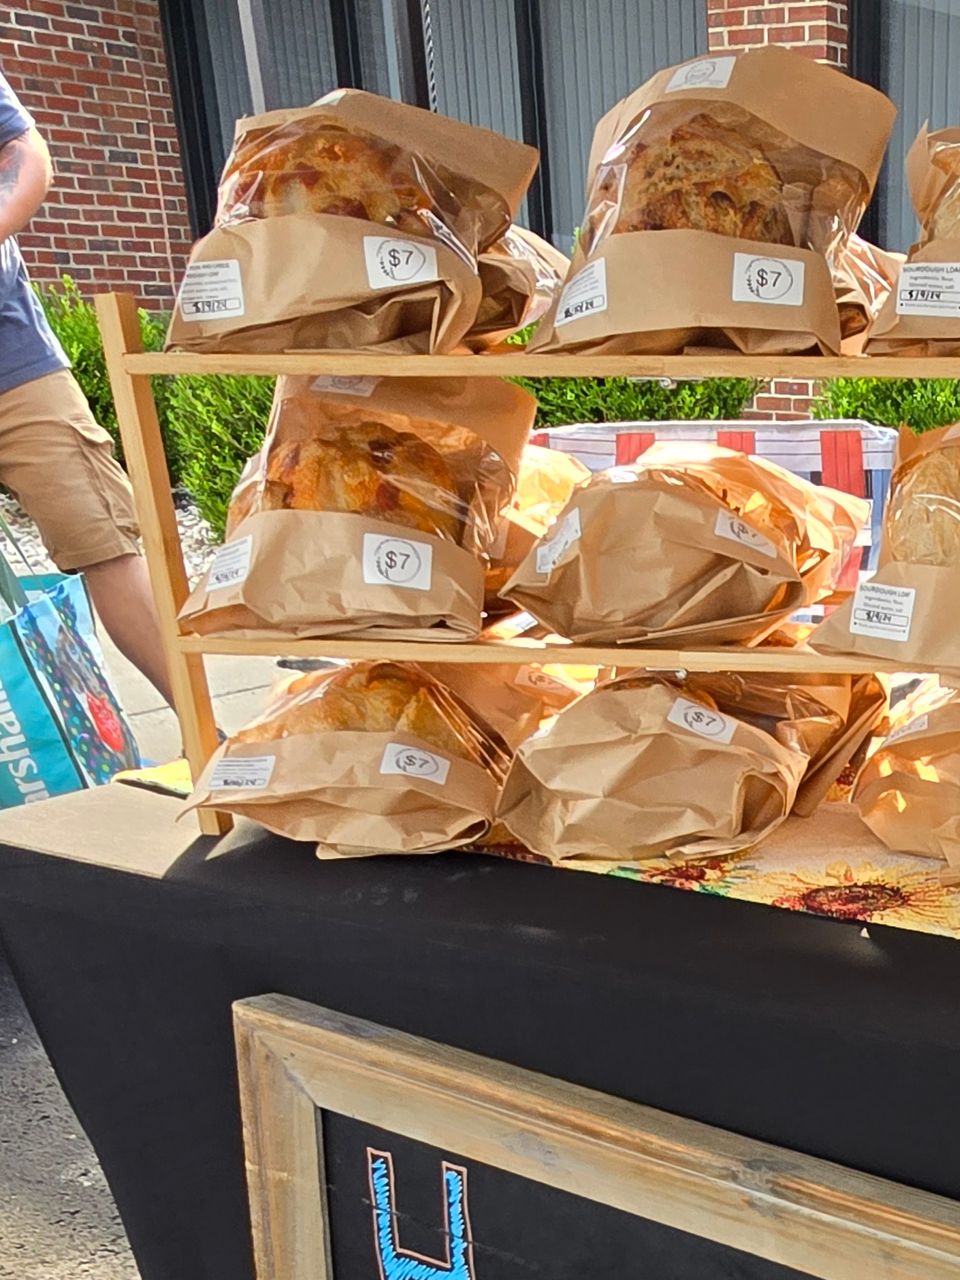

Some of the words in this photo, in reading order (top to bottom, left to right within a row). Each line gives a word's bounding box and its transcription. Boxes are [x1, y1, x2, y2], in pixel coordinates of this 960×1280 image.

[388, 248, 414, 268] $7
[756, 267, 782, 288] $7
[385, 550, 411, 570] $7
[691, 711, 717, 727] $7
[404, 754, 430, 769] $7
